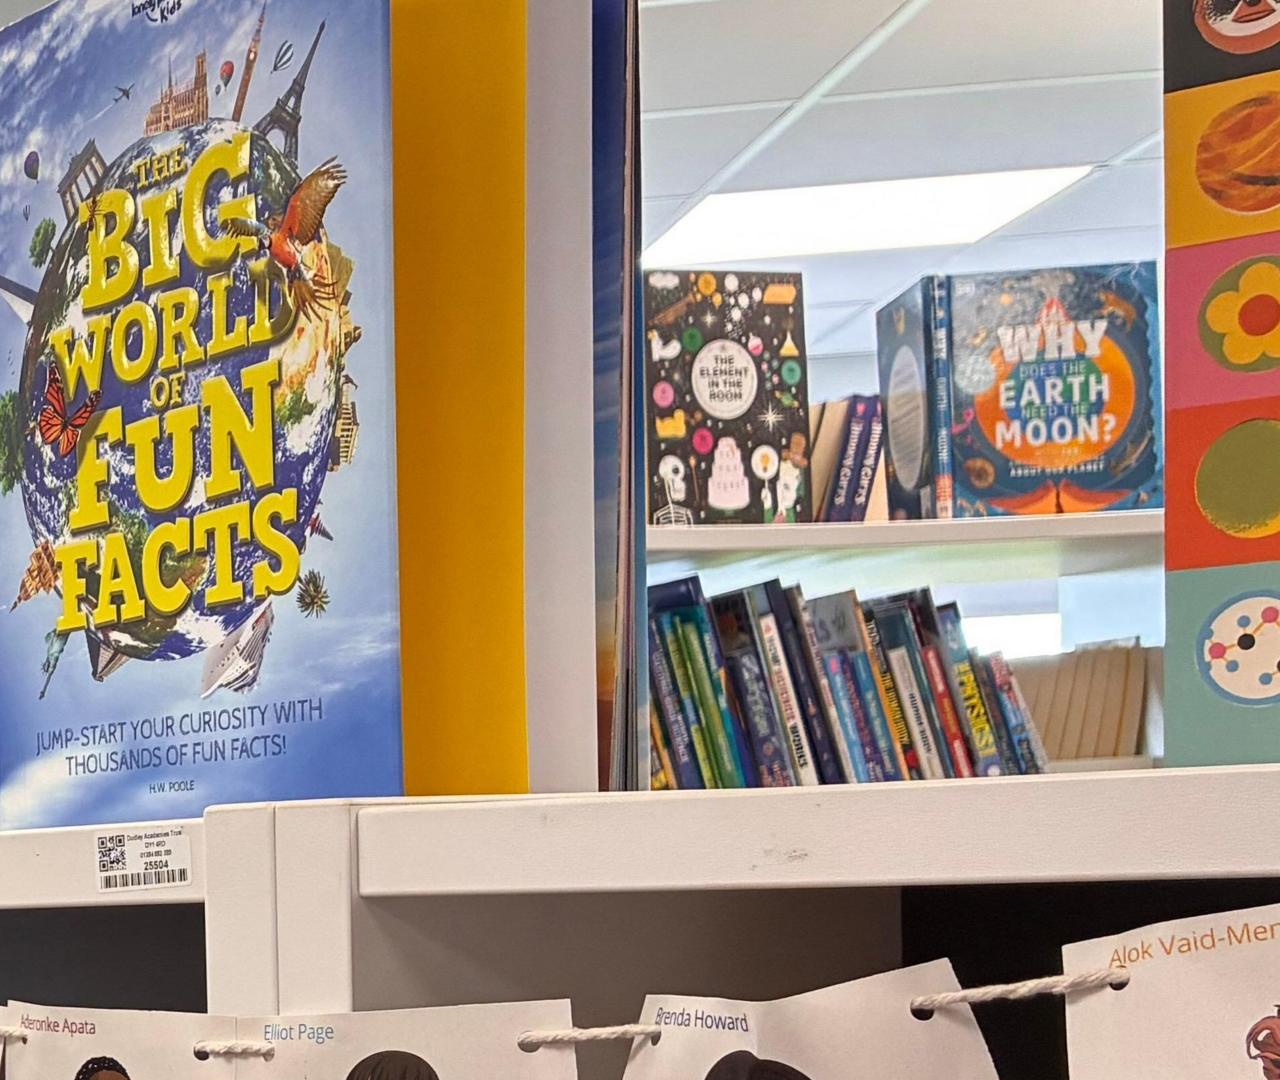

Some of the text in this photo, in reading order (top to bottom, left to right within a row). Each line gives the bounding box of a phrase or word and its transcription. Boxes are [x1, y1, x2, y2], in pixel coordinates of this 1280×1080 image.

[134, 145, 187, 187] THE
[79, 131, 257, 314] BIG
[49, 260, 297, 400] WORLD
[997, 319, 1109, 362] WHY
[699, 366, 749, 377] ELEMENT
[713, 354, 735, 364] THE
[1020, 360, 1086, 378] DOES THE
[150, 372, 187, 408] OF
[708, 378, 742, 389] IN THE
[709, 391, 742, 402] ROOM
[1000, 373, 1111, 409] EARTH
[1022, 402, 1089, 421] NEED THE
[69, 360, 279, 531] FUN
[995, 413, 1117, 450] MOON?
[54, 488, 301, 634] FACTS
[37, 698, 323, 766] JUMP-START YOUR CURIOSITY WITH
[65, 734, 287, 787] THOUSANDS OF FUN FACTS!
[169, 780, 195, 793] POOLE
[144, 860, 169, 871] 25504
[1109, 939, 1153, 969] Alok
[20, 1014, 96, 1037] Aderonke Apata
[264, 1023, 335, 1044] Elliot Page
[655, 1007, 749, 1032] Brenda Howard
